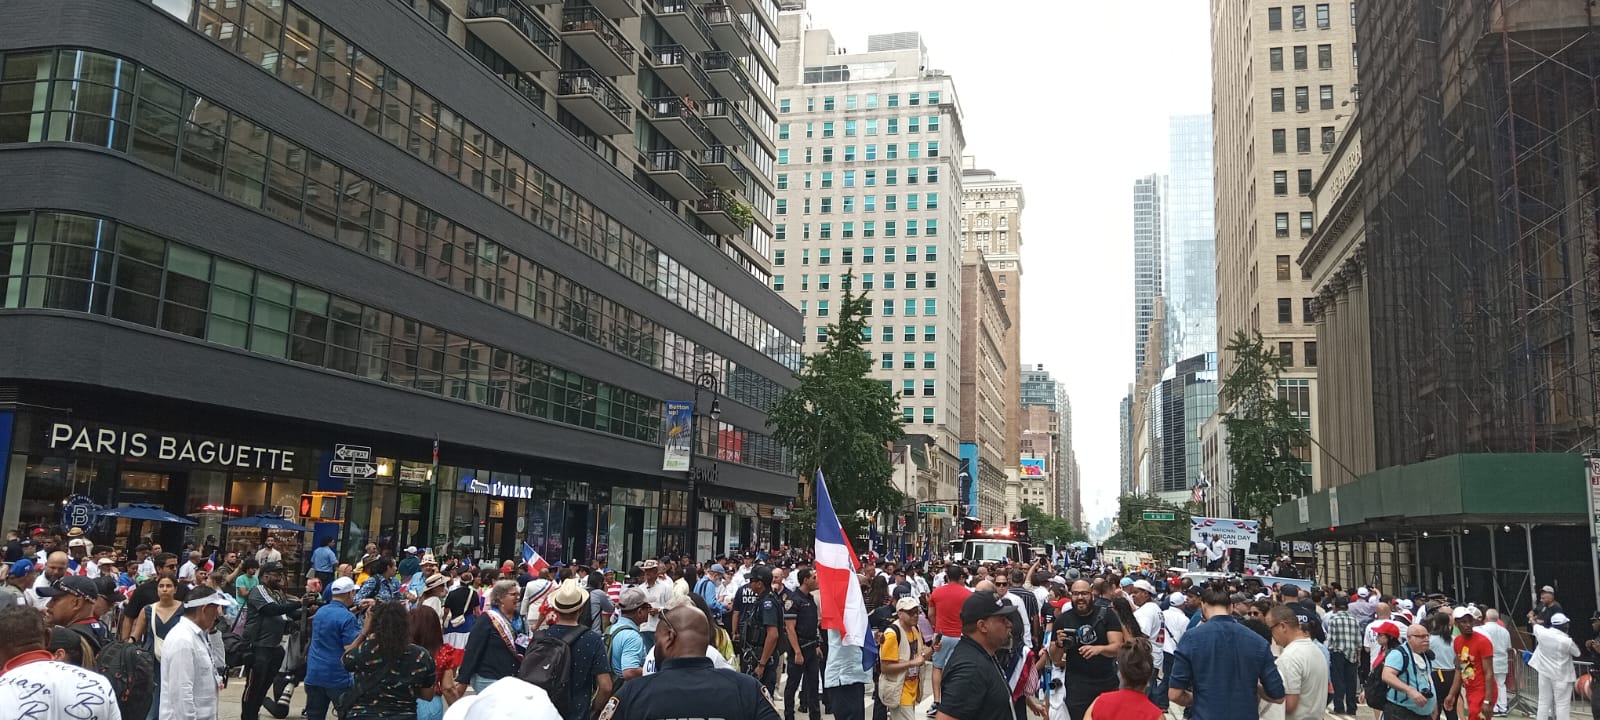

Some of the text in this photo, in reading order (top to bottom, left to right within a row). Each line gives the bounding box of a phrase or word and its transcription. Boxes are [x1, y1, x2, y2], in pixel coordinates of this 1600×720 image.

[50, 423, 295, 472] PARIS BAGUETTE
[356, 466, 371, 474] WAY
[493, 481, 534, 499] I'MILKY
